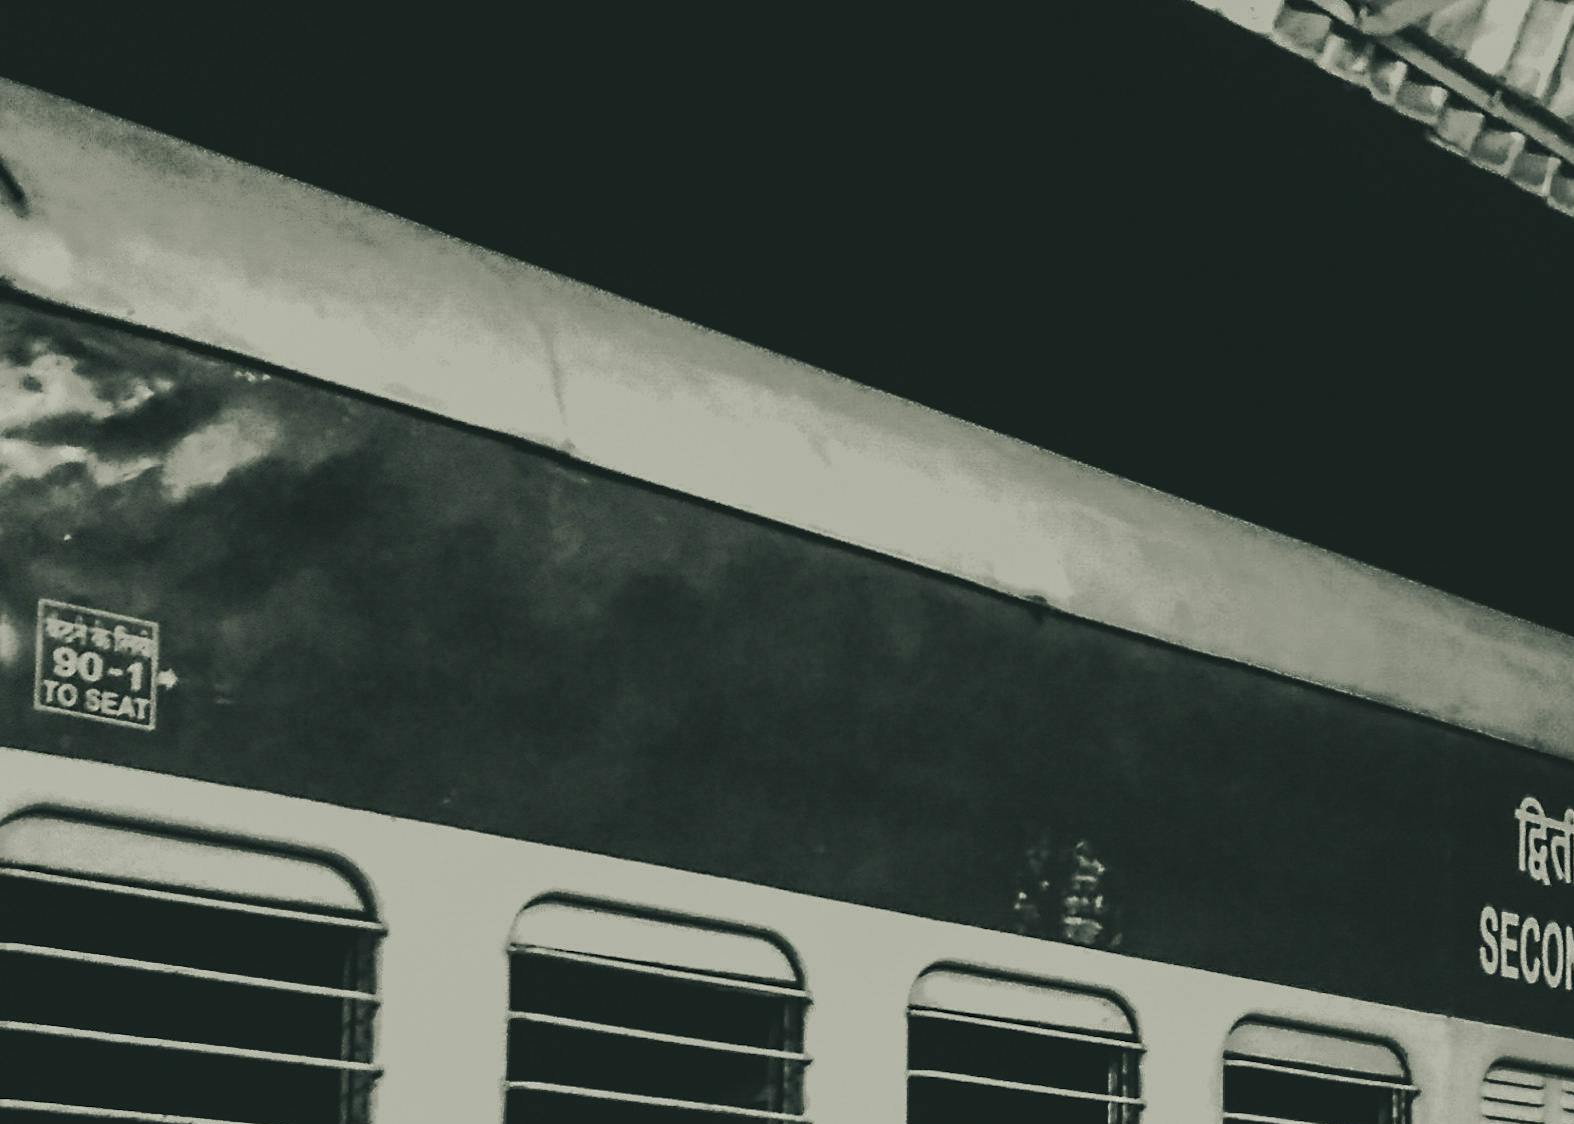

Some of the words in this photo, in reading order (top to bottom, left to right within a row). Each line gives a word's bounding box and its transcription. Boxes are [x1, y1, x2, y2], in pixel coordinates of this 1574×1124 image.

[53, 646, 144, 692] 90-1
[43, 679, 78, 707] TO
[84, 688, 150, 720] SEAT
